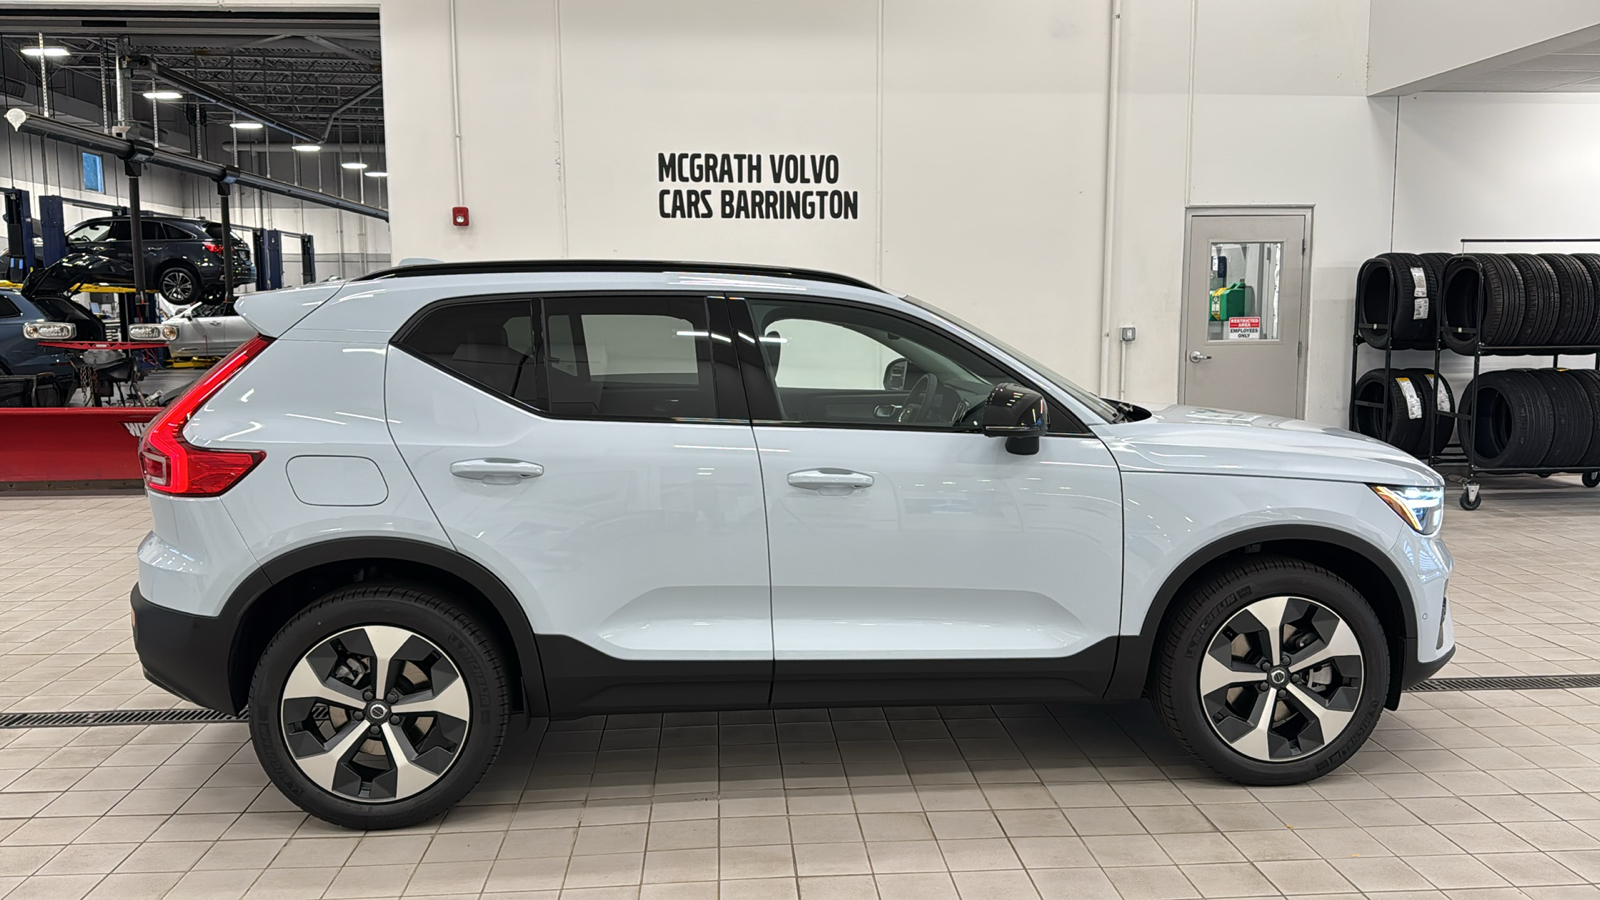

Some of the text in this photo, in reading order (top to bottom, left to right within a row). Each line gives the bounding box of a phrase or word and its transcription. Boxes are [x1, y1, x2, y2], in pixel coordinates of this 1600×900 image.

[658, 153, 839, 184] MCGRATH VOLVO
[659, 189, 858, 220] CARS BARRINGTON
[1190, 593, 1237, 643] MICHELIN
